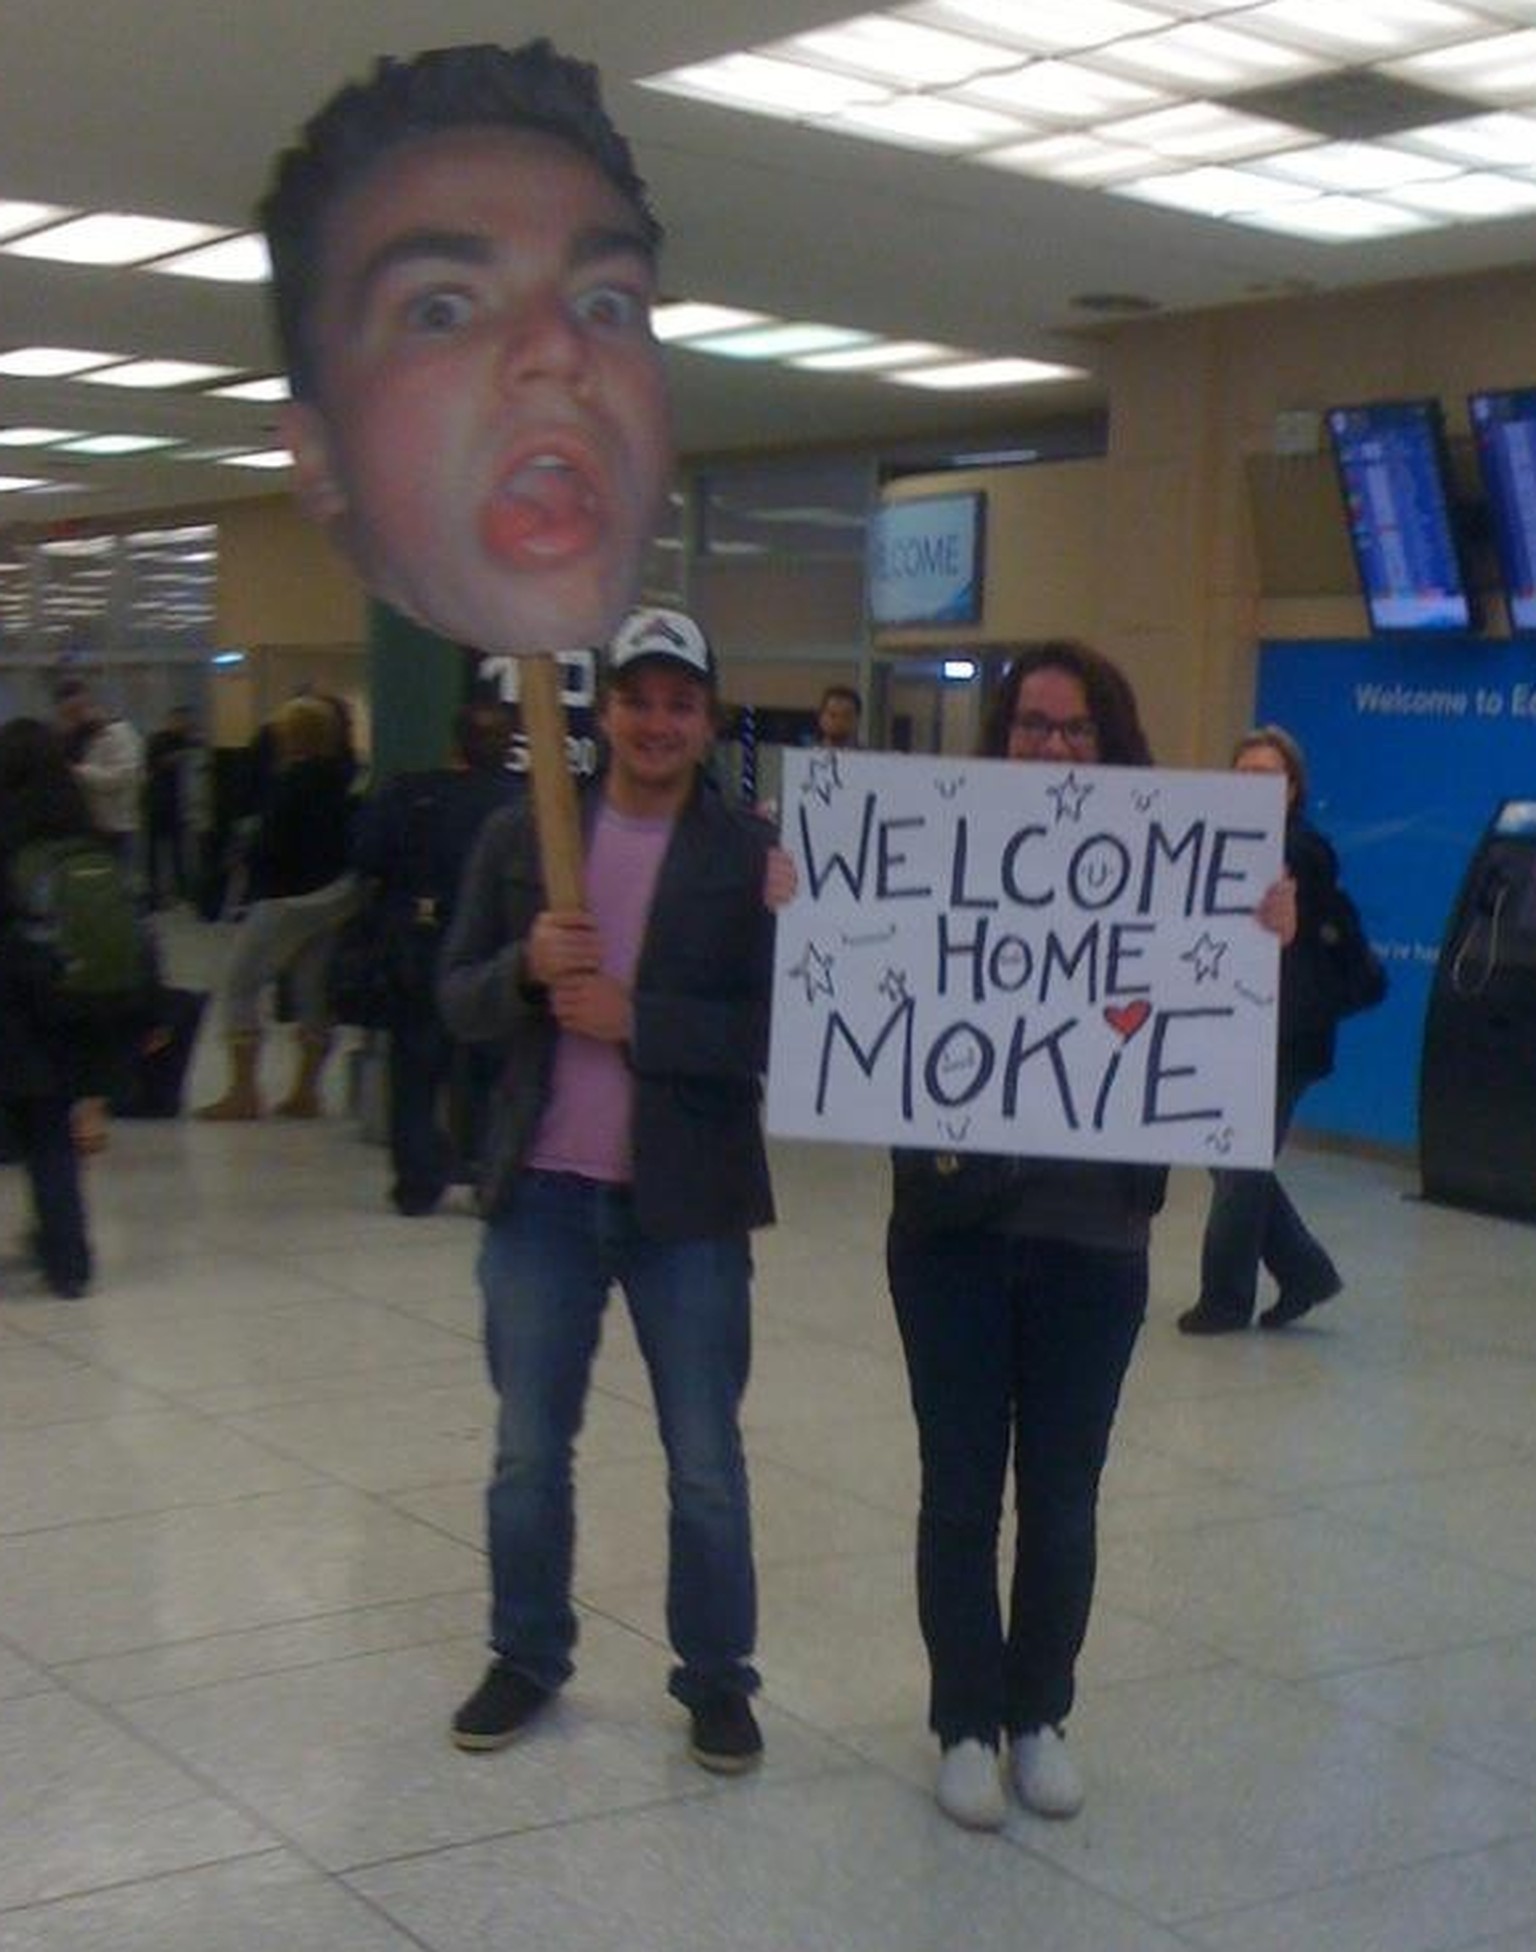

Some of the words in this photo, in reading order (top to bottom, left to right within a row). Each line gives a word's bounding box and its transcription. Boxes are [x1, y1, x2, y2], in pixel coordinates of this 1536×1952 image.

[1355, 682, 1467, 714] Welcome
[1476, 687, 1503, 715] to
[799, 792, 1267, 917] WELCOME
[937, 912, 1157, 1003] HOME
